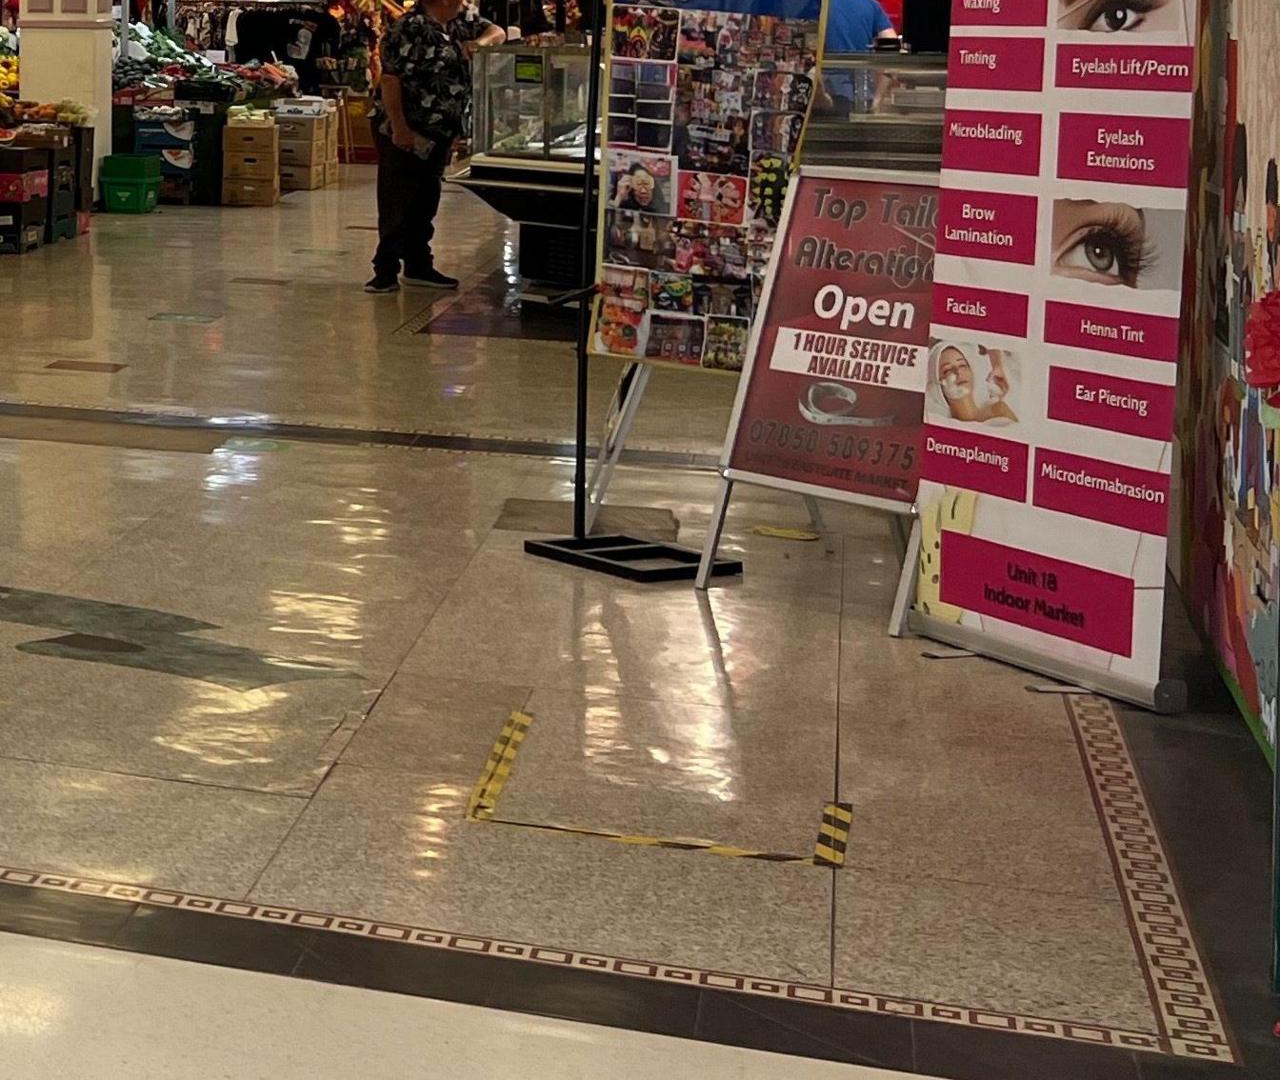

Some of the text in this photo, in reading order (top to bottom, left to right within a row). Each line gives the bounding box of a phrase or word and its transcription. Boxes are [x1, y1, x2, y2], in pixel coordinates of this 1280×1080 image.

[959, 50, 997, 69] Tinting
[1072, 58, 1189, 78] Eyelash Lift/Perm
[949, 122, 1023, 145] Microblading
[1097, 128, 1144, 148] Eyelash
[1086, 151, 1155, 171] Extenxions
[812, 187, 868, 229] Top
[962, 204, 996, 221] Brow
[945, 224, 1013, 248] Lamination
[813, 283, 915, 331] Open
[946, 298, 987, 318] Facials
[1080, 320, 1145, 344] Henna Tint
[793, 332, 918, 368] 1 HOUR SERVICE
[806, 358, 890, 385] AVAILABLE
[1075, 384, 1149, 417] Ear Piercing
[926, 437, 1009, 472] Dermaplaning
[1041, 463, 1165, 505] Microdermabrasion
[1006, 562, 1058, 593] Unit 18
[984, 583, 1085, 629] Indoor Market
